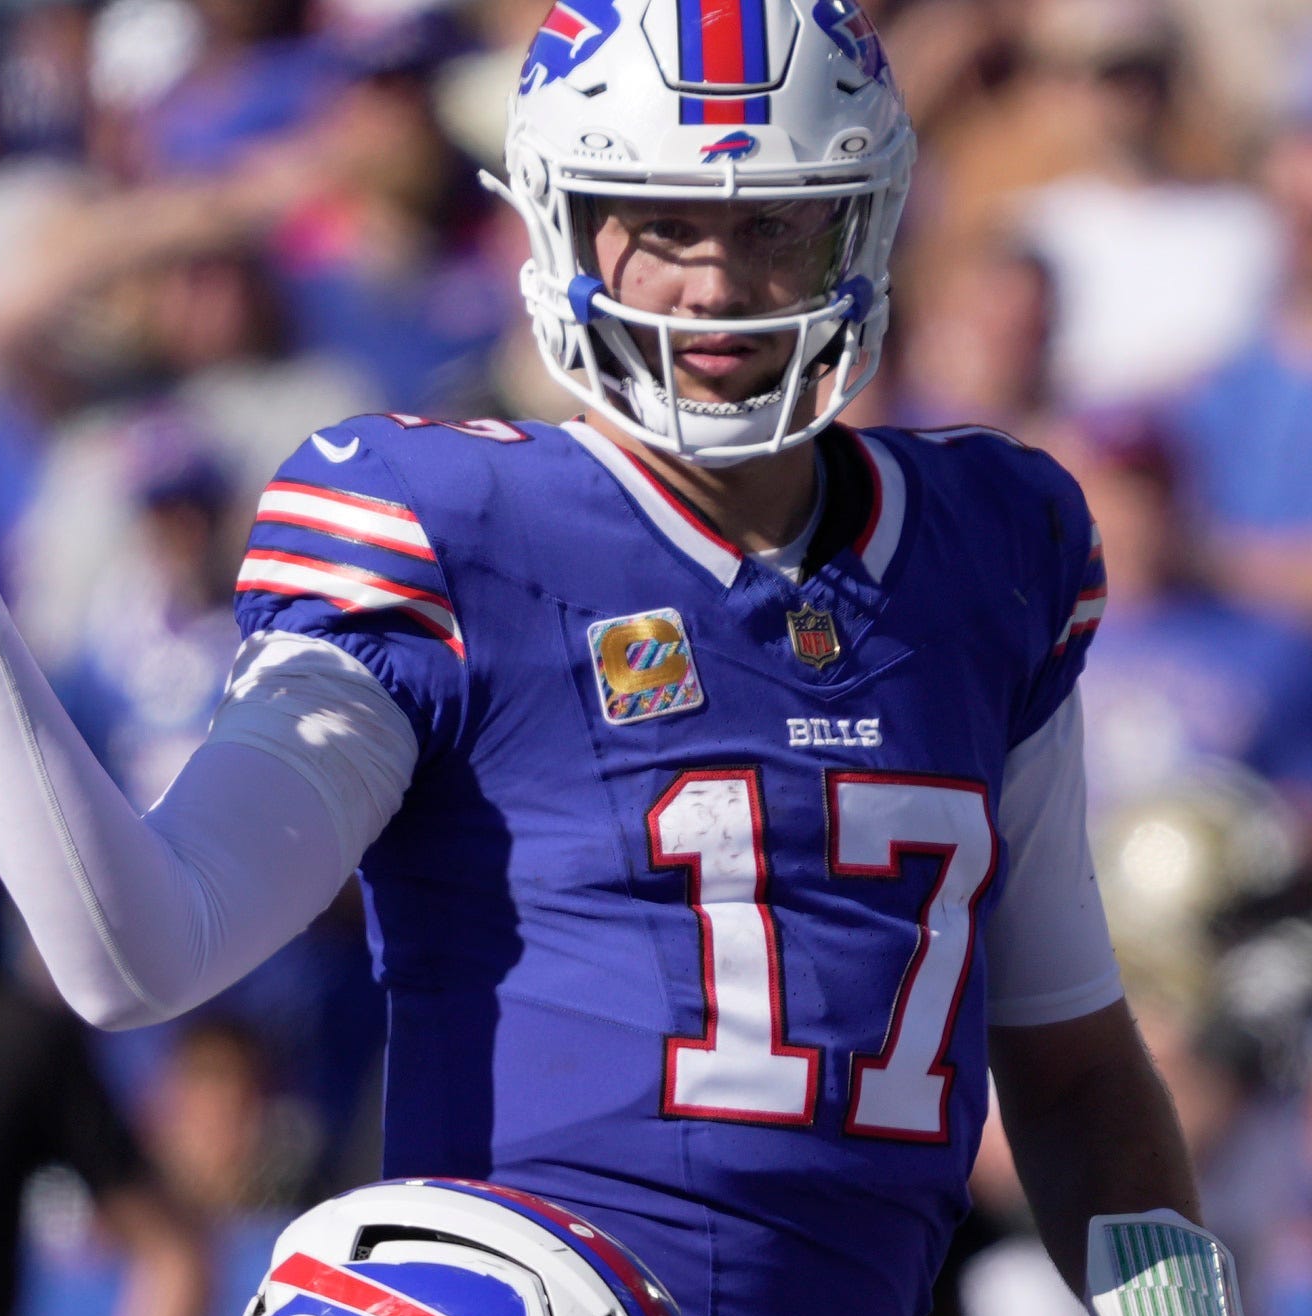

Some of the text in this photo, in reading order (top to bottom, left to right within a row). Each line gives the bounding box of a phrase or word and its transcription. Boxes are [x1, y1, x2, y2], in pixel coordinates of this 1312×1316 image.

[800, 631, 835, 655] NFL
[786, 717, 884, 747] BILLS
[646, 764, 999, 1144] 17
